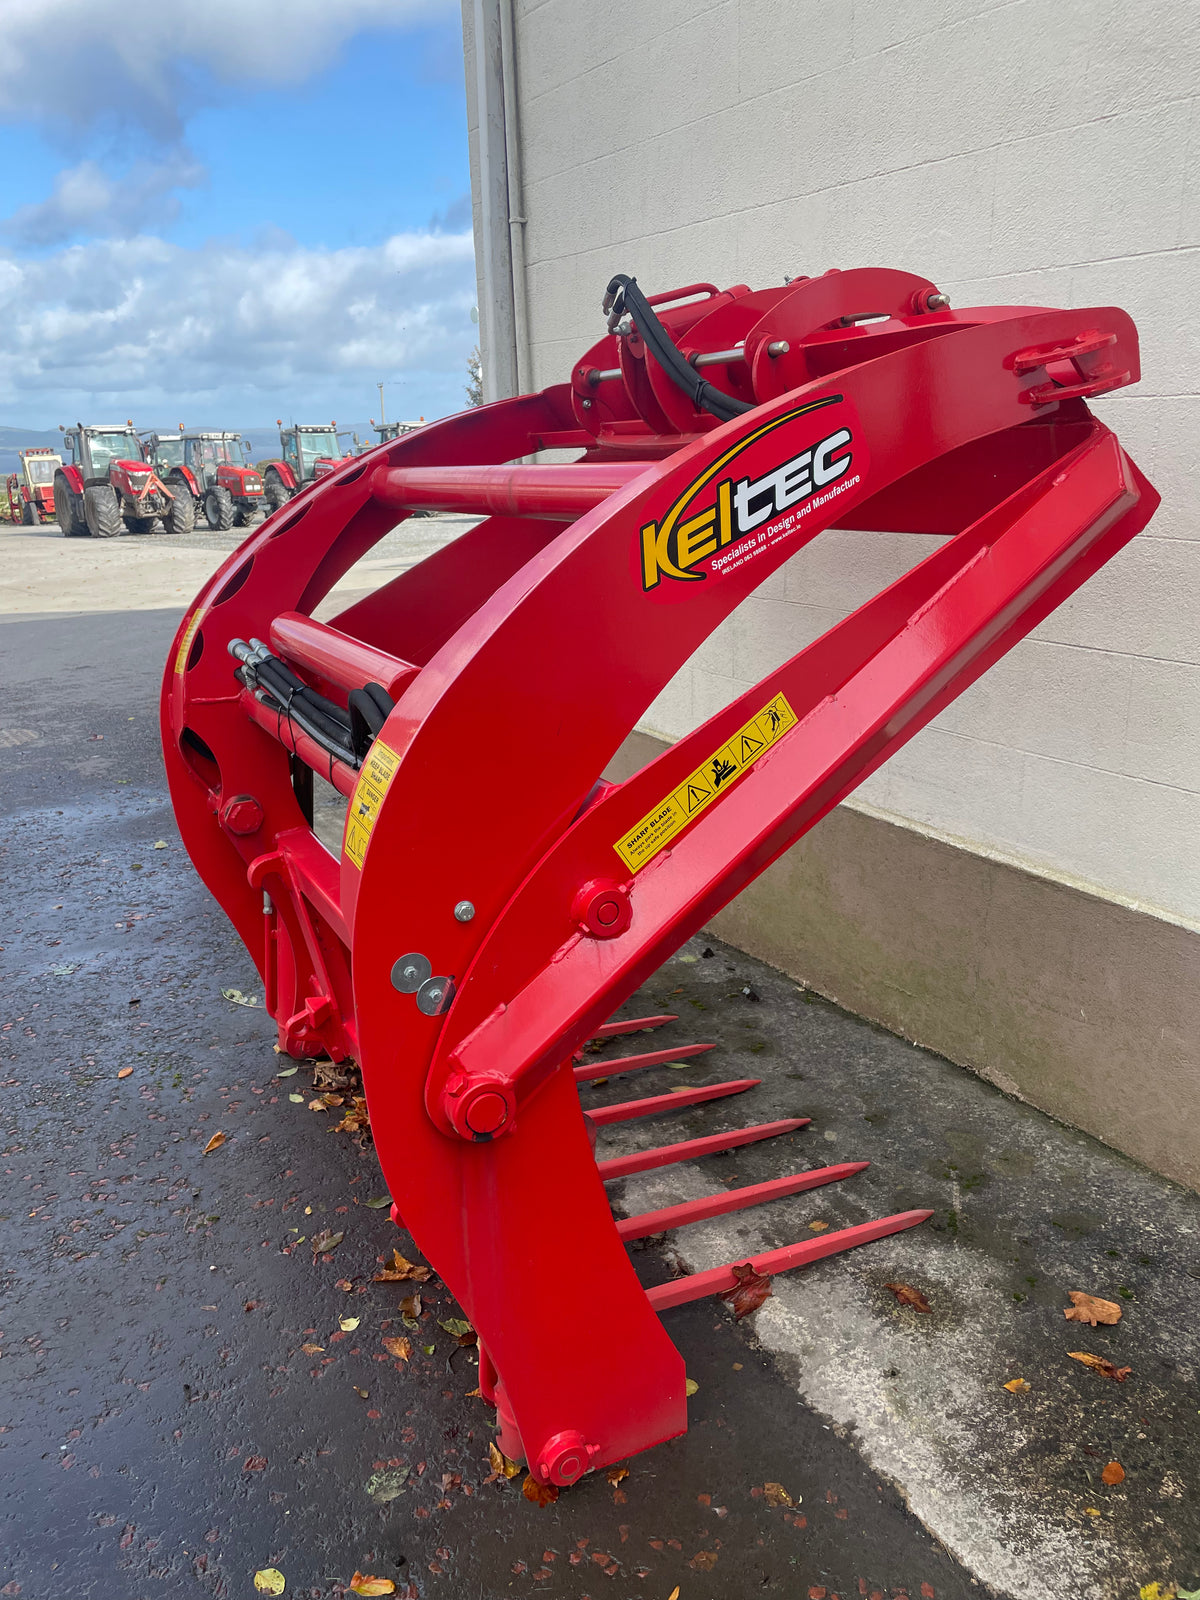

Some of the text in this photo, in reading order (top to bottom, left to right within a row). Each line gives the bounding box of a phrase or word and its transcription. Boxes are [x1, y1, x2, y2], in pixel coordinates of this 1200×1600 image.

[711, 475, 860, 571] Specialists in Design and Manufacture
[721, 558, 744, 575] IRELAND
[370, 760, 390, 781] KEEP BLADE
[371, 771, 382, 784] SHARP
[366, 788, 379, 803] DANGER
[627, 806, 672, 848] SHARP BLADE
[630, 841, 645, 856] Always
[645, 833, 654, 843] park
[661, 815, 673, 827] blade
[650, 835, 660, 844] safe
[659, 820, 676, 837] position
